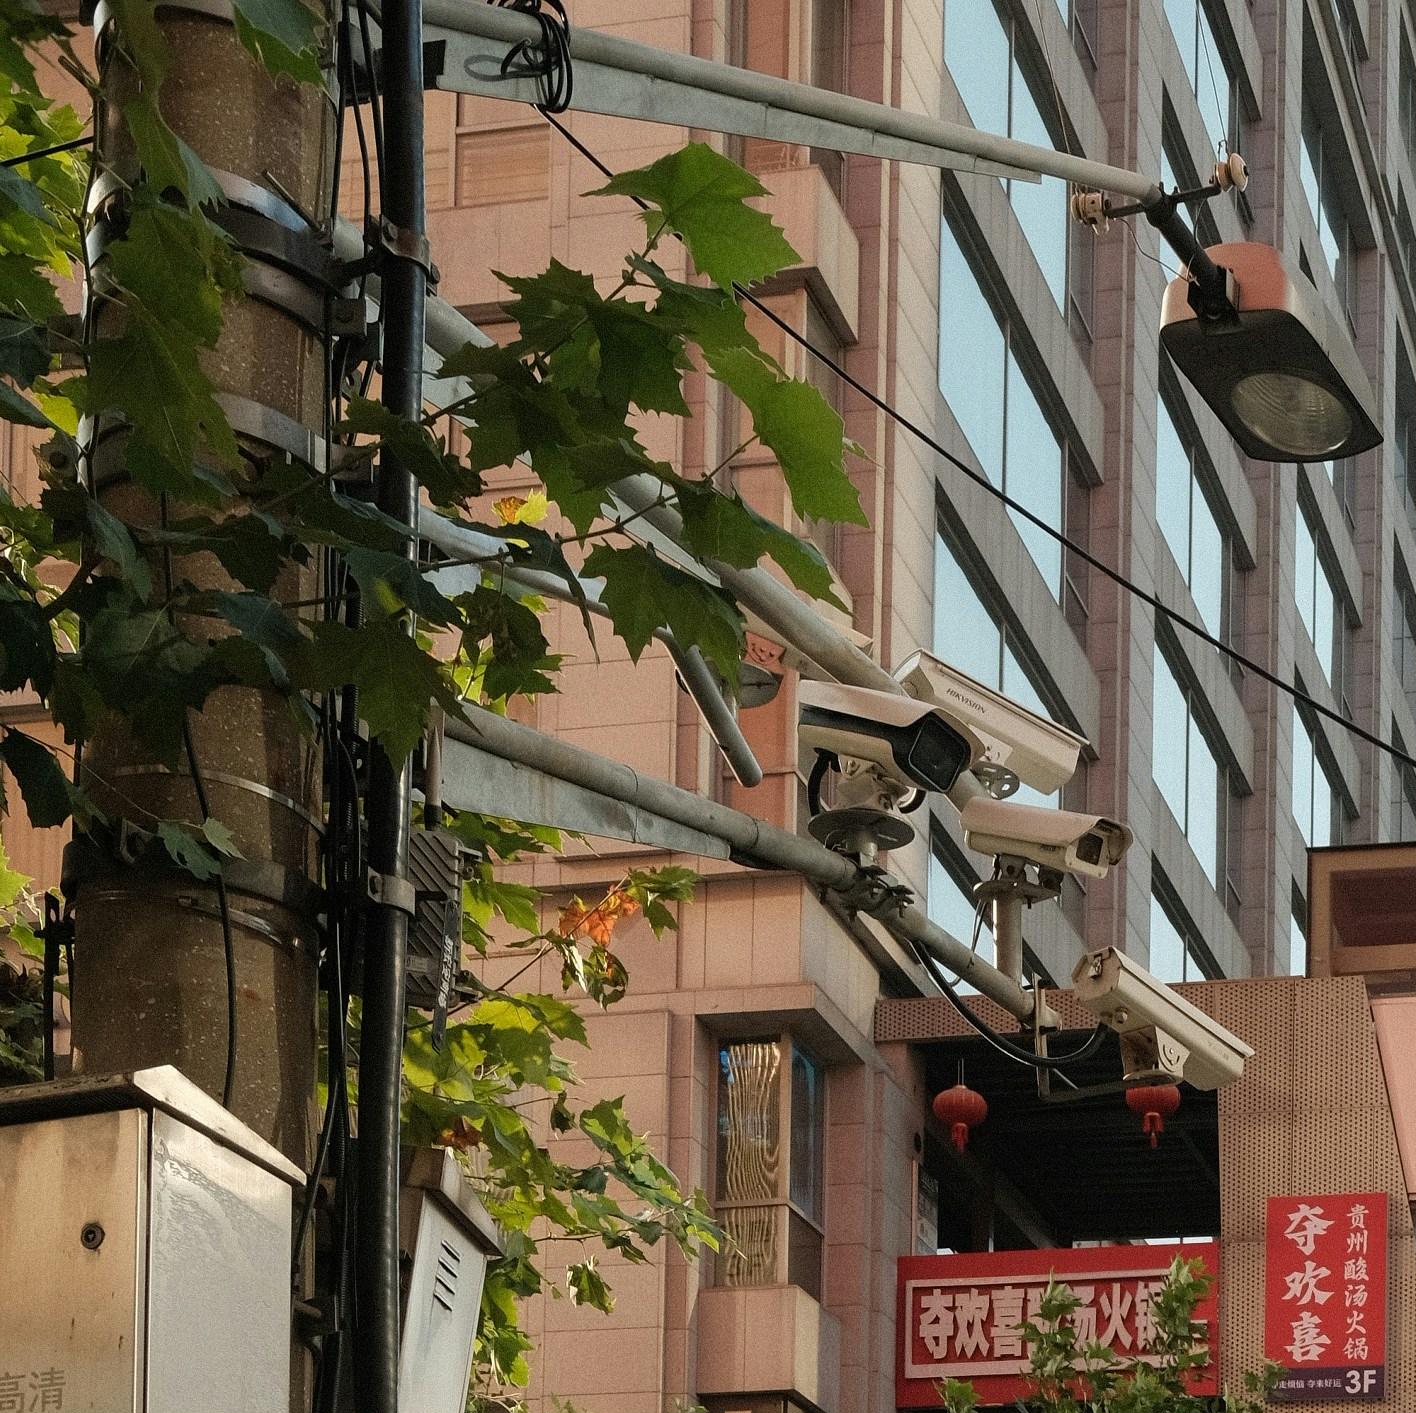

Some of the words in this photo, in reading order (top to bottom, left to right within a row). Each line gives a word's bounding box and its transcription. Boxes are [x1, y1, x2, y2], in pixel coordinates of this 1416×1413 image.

[946, 687, 987, 714] HIKVISION
[1281, 1203, 1336, 1363] 夺欢喜
[1342, 1203, 1370, 1361] 贵州酸汤火锅
[1306, 1377, 1342, 1390] 夺来好运
[1344, 1369, 1377, 1395] 3F
